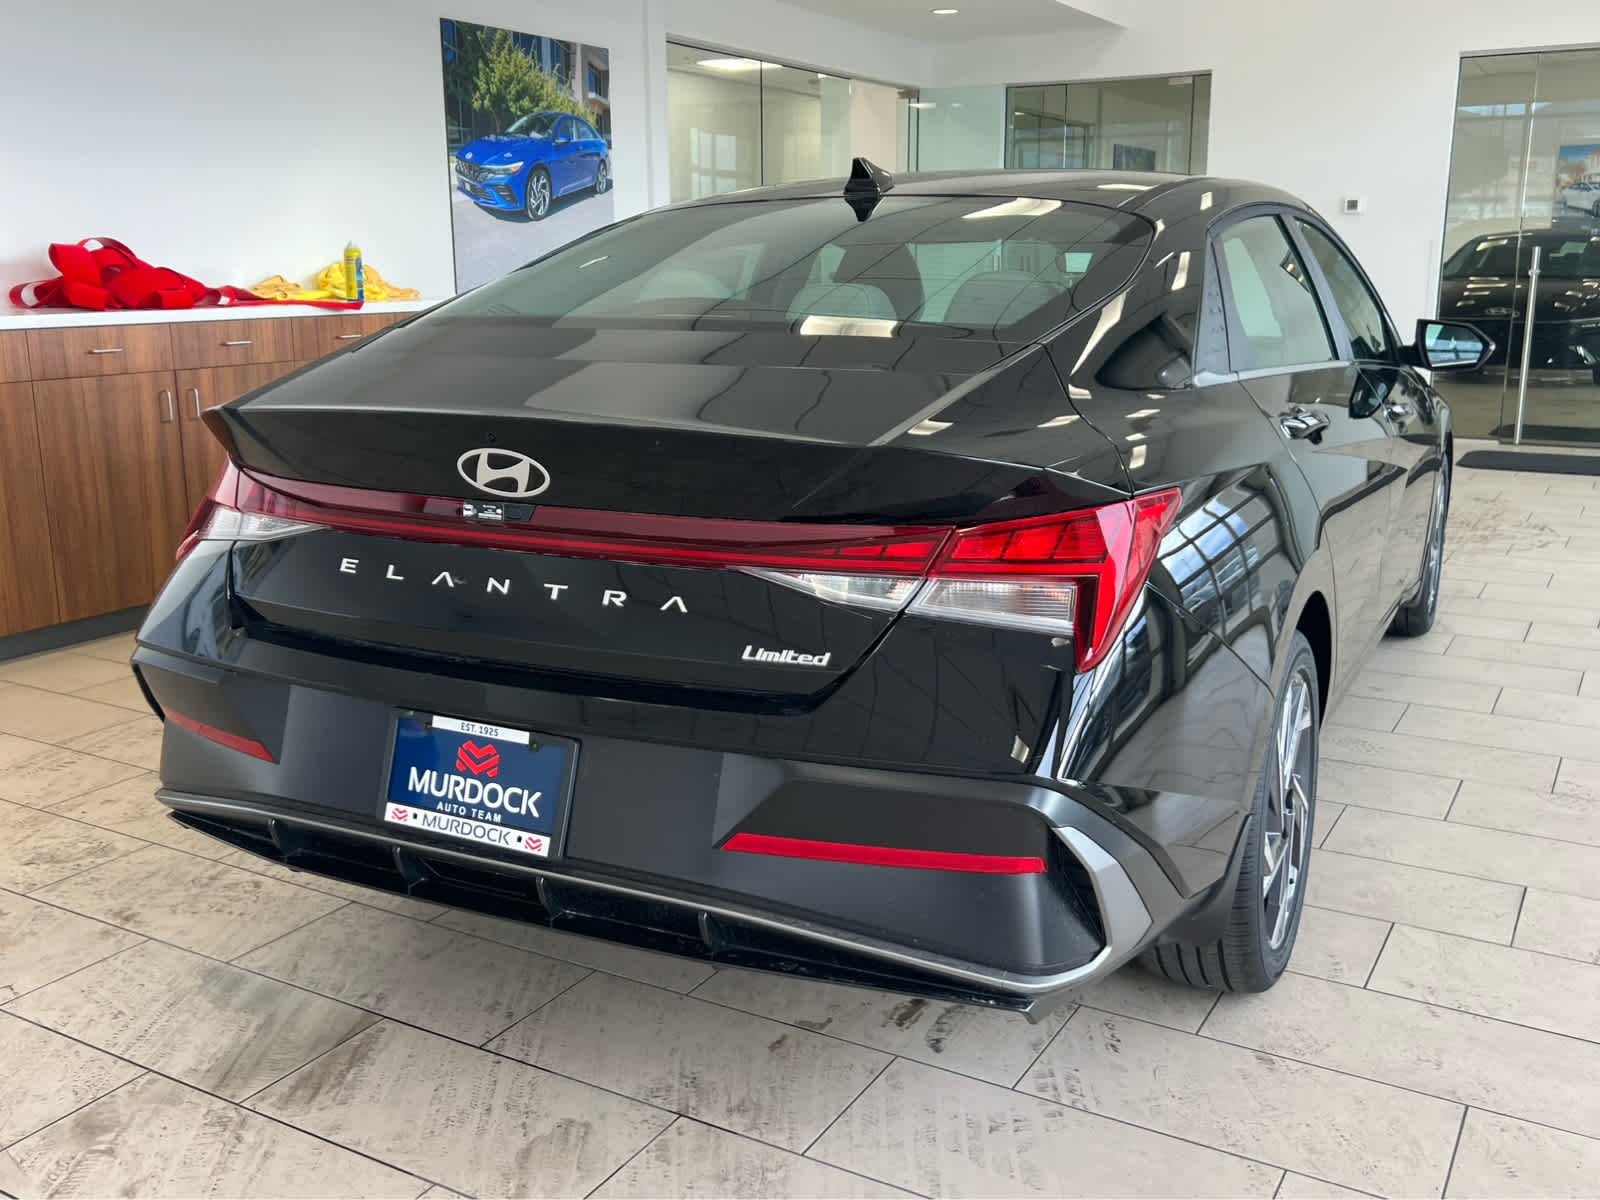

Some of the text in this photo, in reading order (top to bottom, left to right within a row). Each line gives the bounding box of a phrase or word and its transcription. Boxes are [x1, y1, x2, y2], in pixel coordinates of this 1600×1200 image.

[339, 558, 688, 613] ELANTRA
[741, 644, 831, 667] Limited
[460, 722, 499, 737] EST. 1925
[408, 766, 542, 818] MURDOCK
[436, 801, 502, 823] AUTO TEAM
[422, 813, 511, 846] MURDOCK
